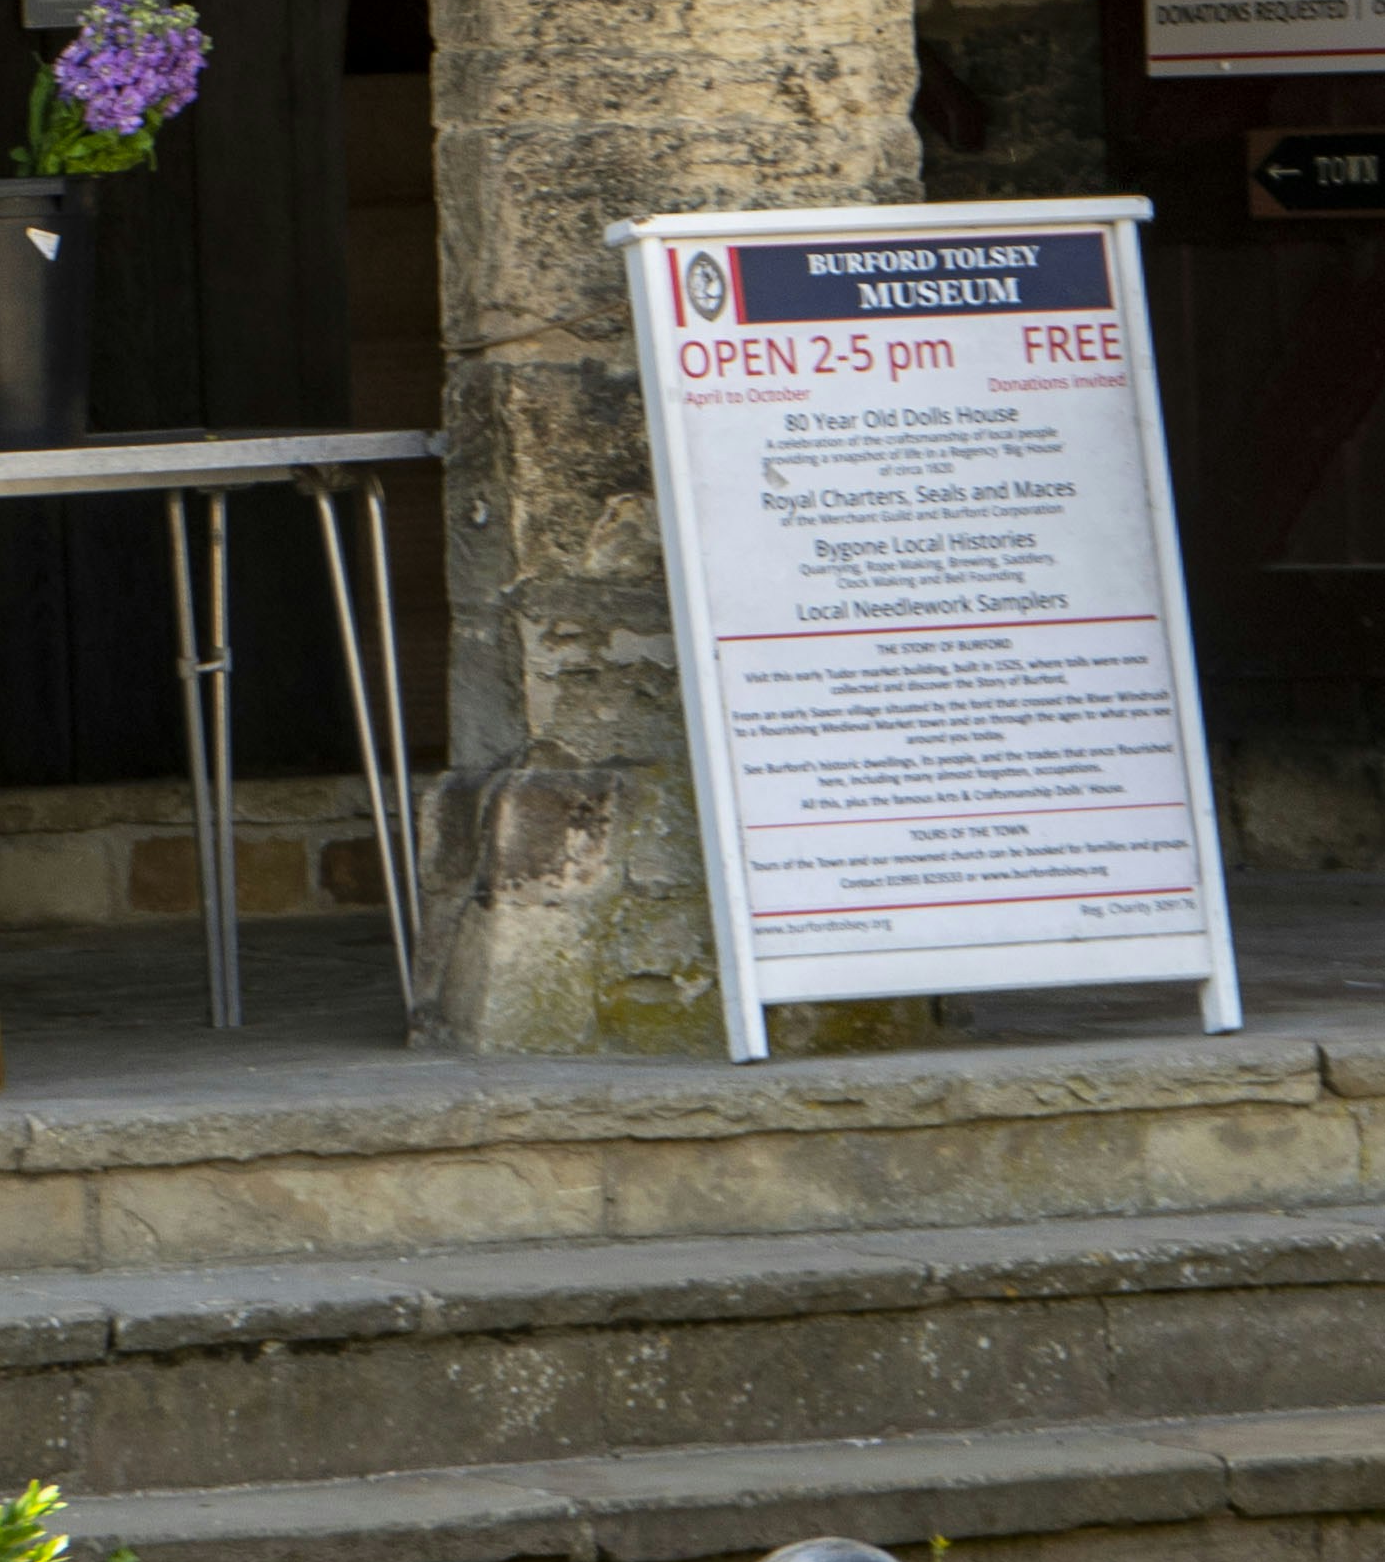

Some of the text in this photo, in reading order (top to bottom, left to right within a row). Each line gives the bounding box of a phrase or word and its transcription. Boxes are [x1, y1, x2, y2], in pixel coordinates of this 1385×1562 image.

[1156, 3, 1251, 24] DONATIONS
[1313, 154, 1379, 186] TOWN
[806, 245, 1040, 275] BURFORD TOLSEY
[857, 277, 1021, 309] MUSEUM
[679, 334, 953, 381] OPEN 2-5 pm
[1022, 323, 1122, 363] FREE
[684, 386, 810, 406] April to October
[987, 372, 1126, 392] Donations invited
[785, 407, 1018, 431] 80 Year Old Dolls House
[761, 481, 1076, 514] Royal Charters, Seals and Maces
[814, 532, 1036, 561] Bygone Local Histories
[796, 591, 1068, 621] Local Needlework Samplers
